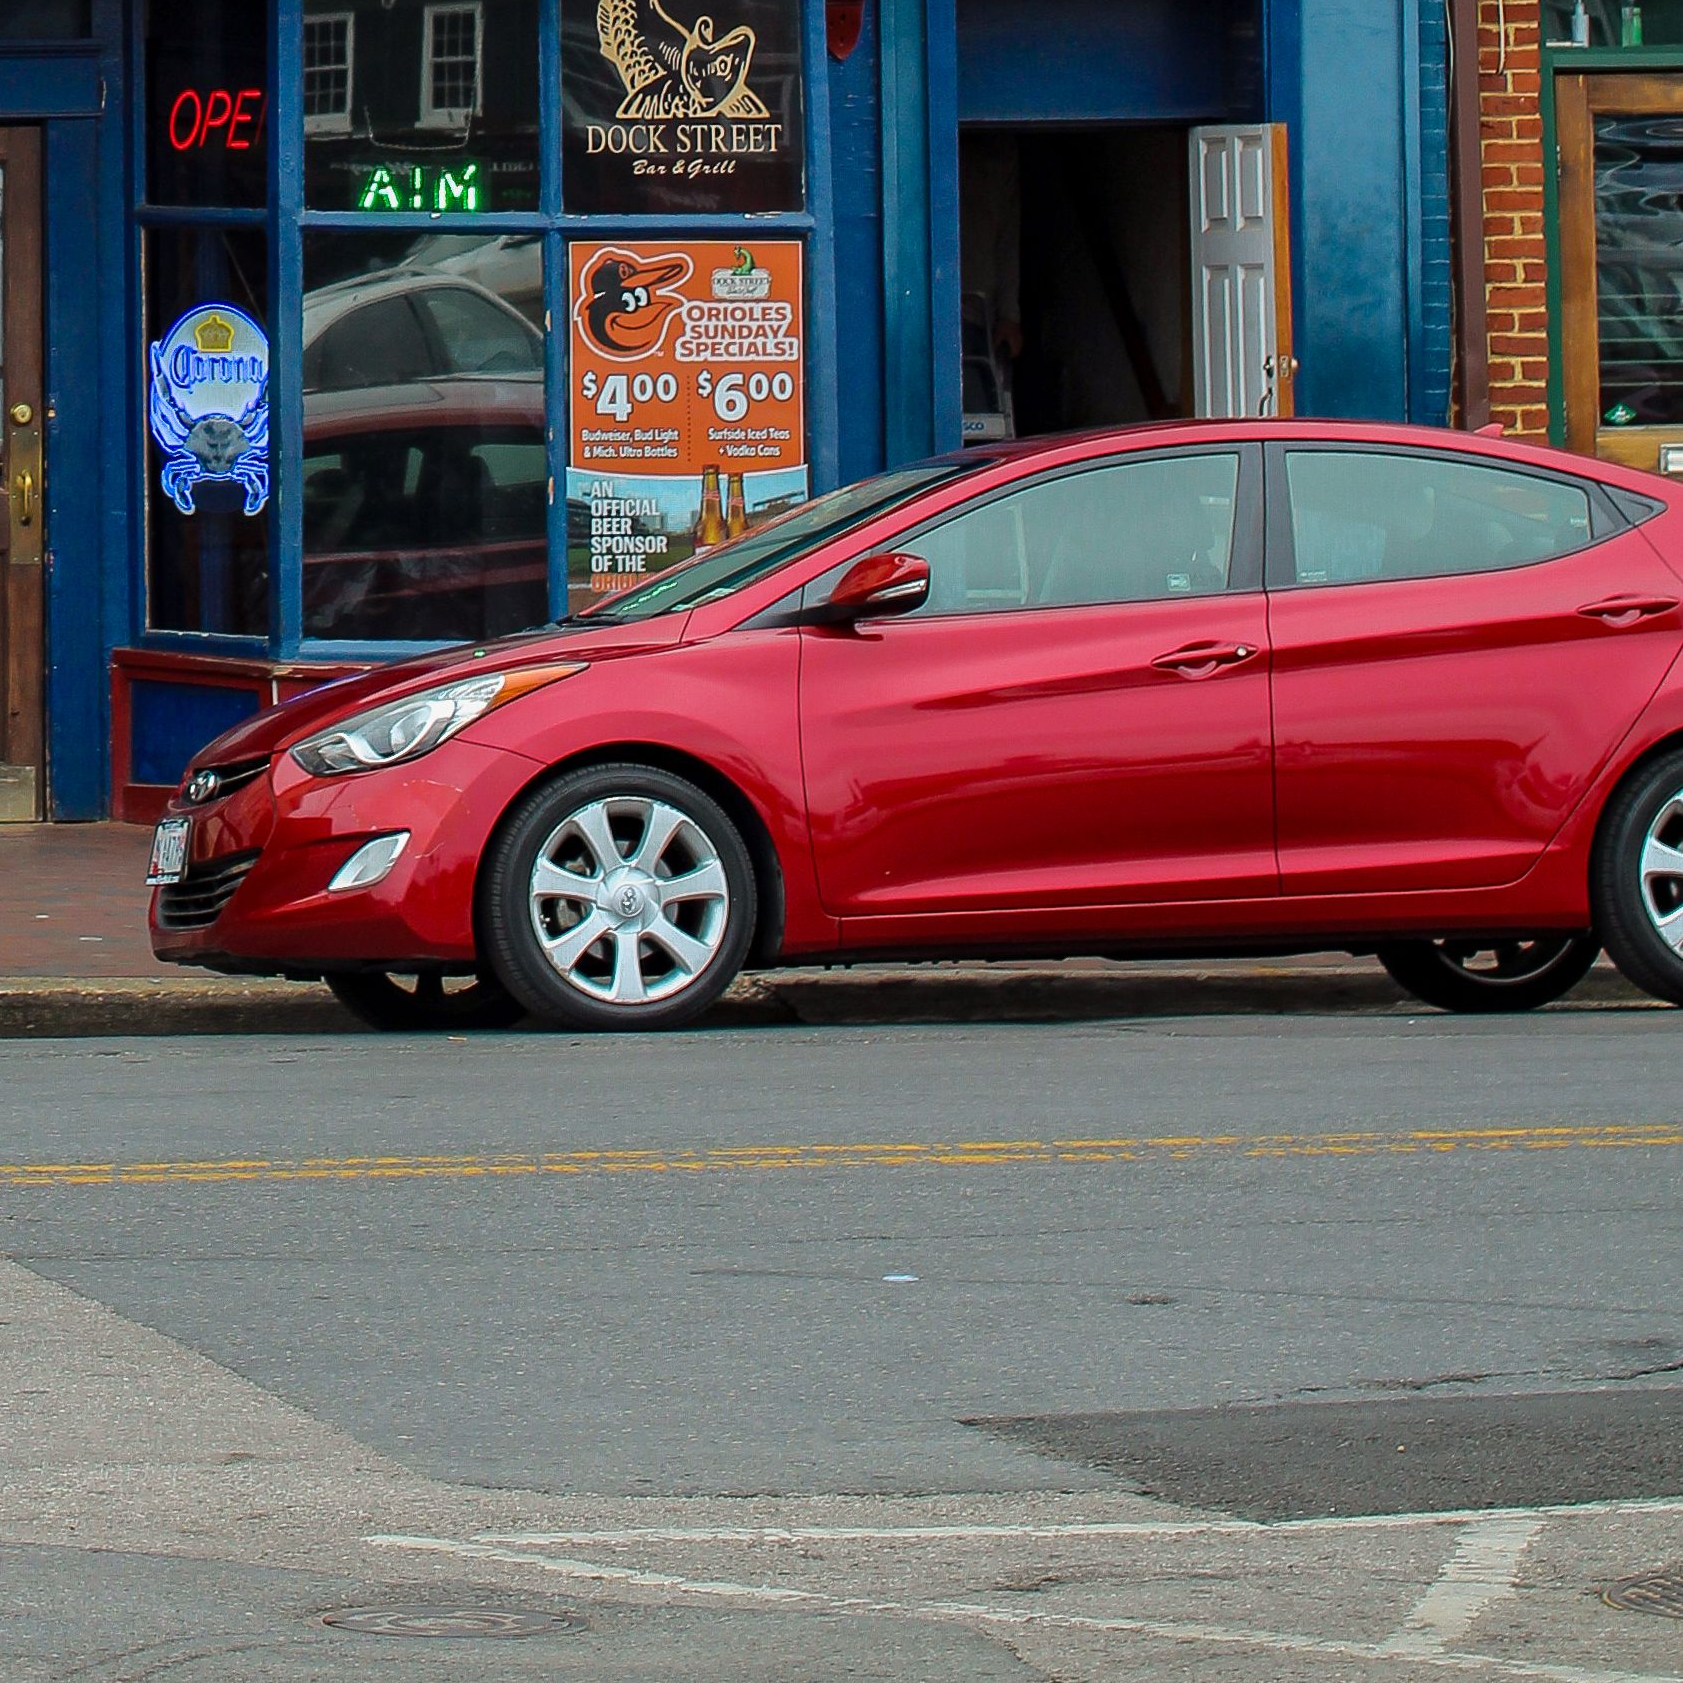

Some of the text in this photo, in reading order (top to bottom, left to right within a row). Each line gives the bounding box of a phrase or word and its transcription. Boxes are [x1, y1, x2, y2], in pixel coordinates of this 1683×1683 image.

[586, 123, 782, 154] DOCK STREET
[632, 159, 737, 179] Bar & Grill
[686, 305, 788, 323] ORIOLES
[690, 324, 782, 340] SUNDAY
[680, 340, 796, 358] SPECIALS!
[169, 345, 263, 391] Corona
[581, 428, 679, 444] Budweiser, Bud Light
[708, 428, 791, 441] Surfside Iced Teas
[583, 445, 678, 458] & Mich. Ultra Bottles
[725, 444, 756, 457] Vodka
[757, 445, 781, 457] Cans
[591, 481, 614, 497] AN
[591, 499, 660, 517] OFFICIAL
[591, 517, 632, 535] BEER
[590, 536, 668, 554] SPONSOR
[591, 555, 646, 572] OF THE
[590, 573, 655, 592] ORIO
